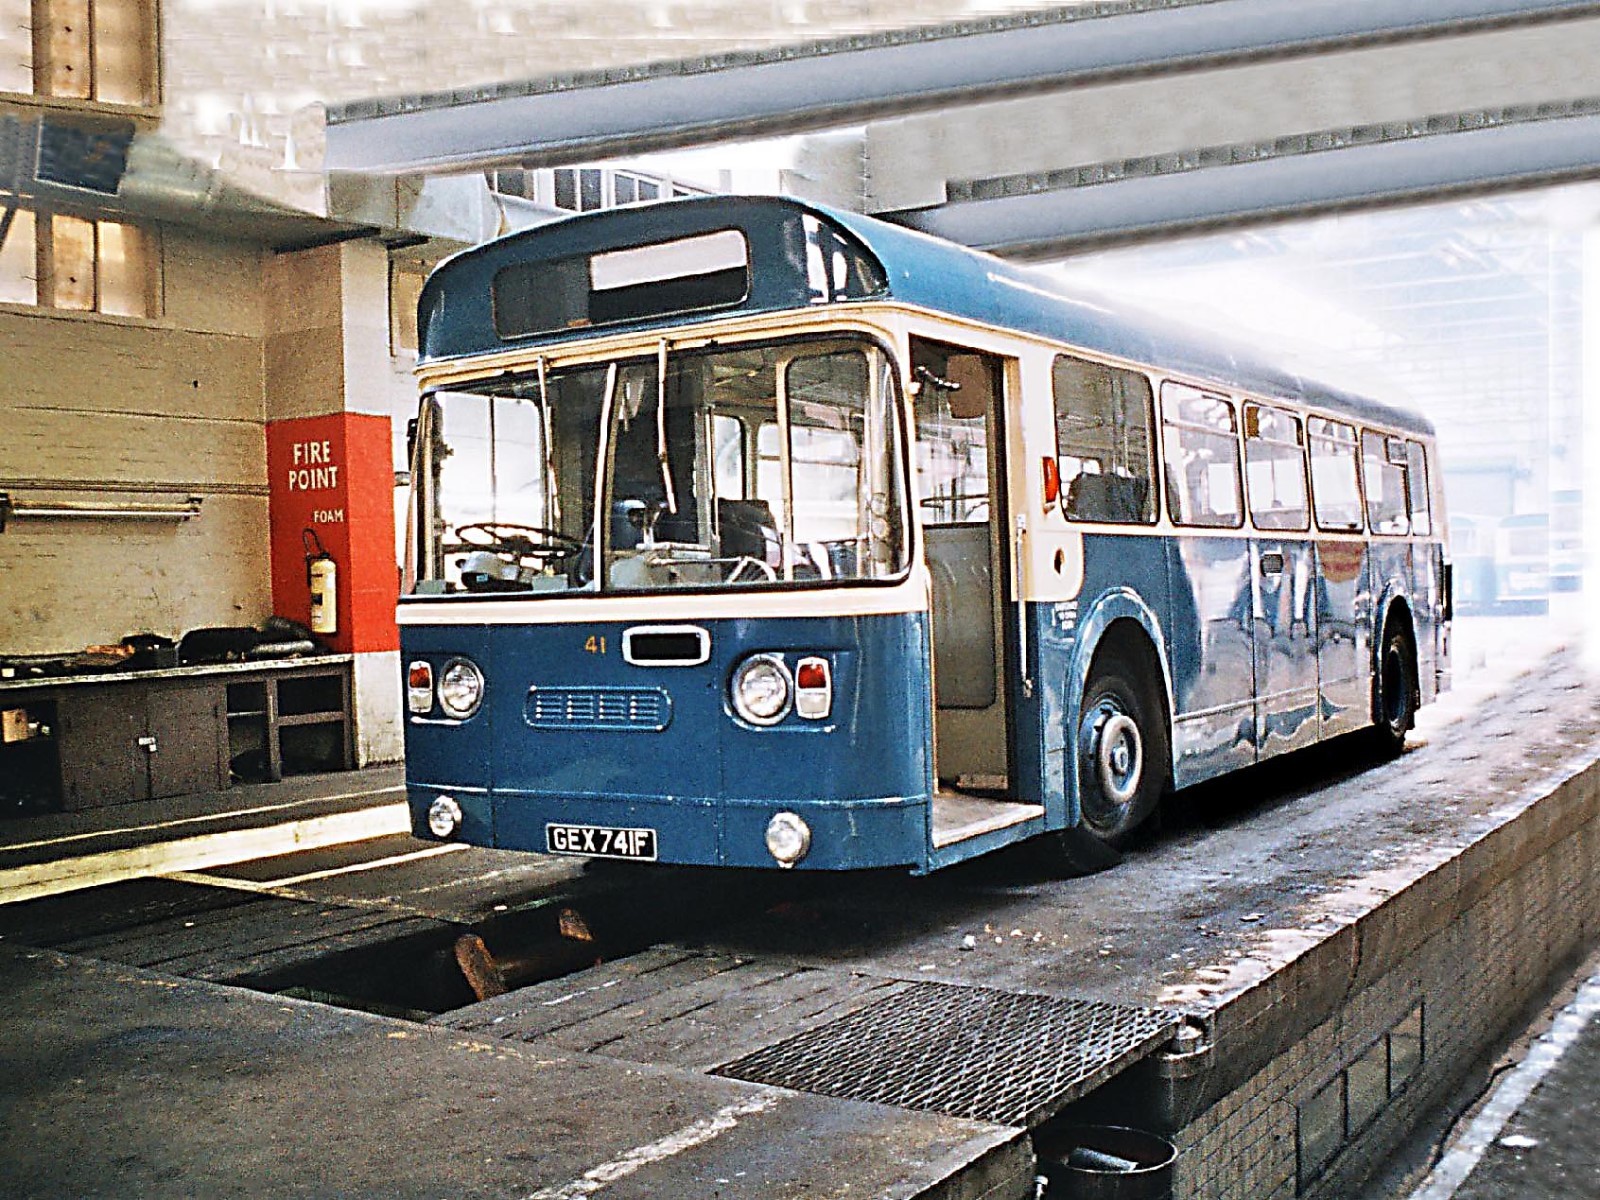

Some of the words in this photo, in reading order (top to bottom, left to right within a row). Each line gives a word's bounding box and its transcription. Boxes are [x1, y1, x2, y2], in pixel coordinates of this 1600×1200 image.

[293, 441, 330, 465] FIRE
[288, 466, 338, 491] POINT
[313, 509, 344, 523] FOAM
[584, 636, 607, 654] 41
[552, 828, 597, 852] GEX
